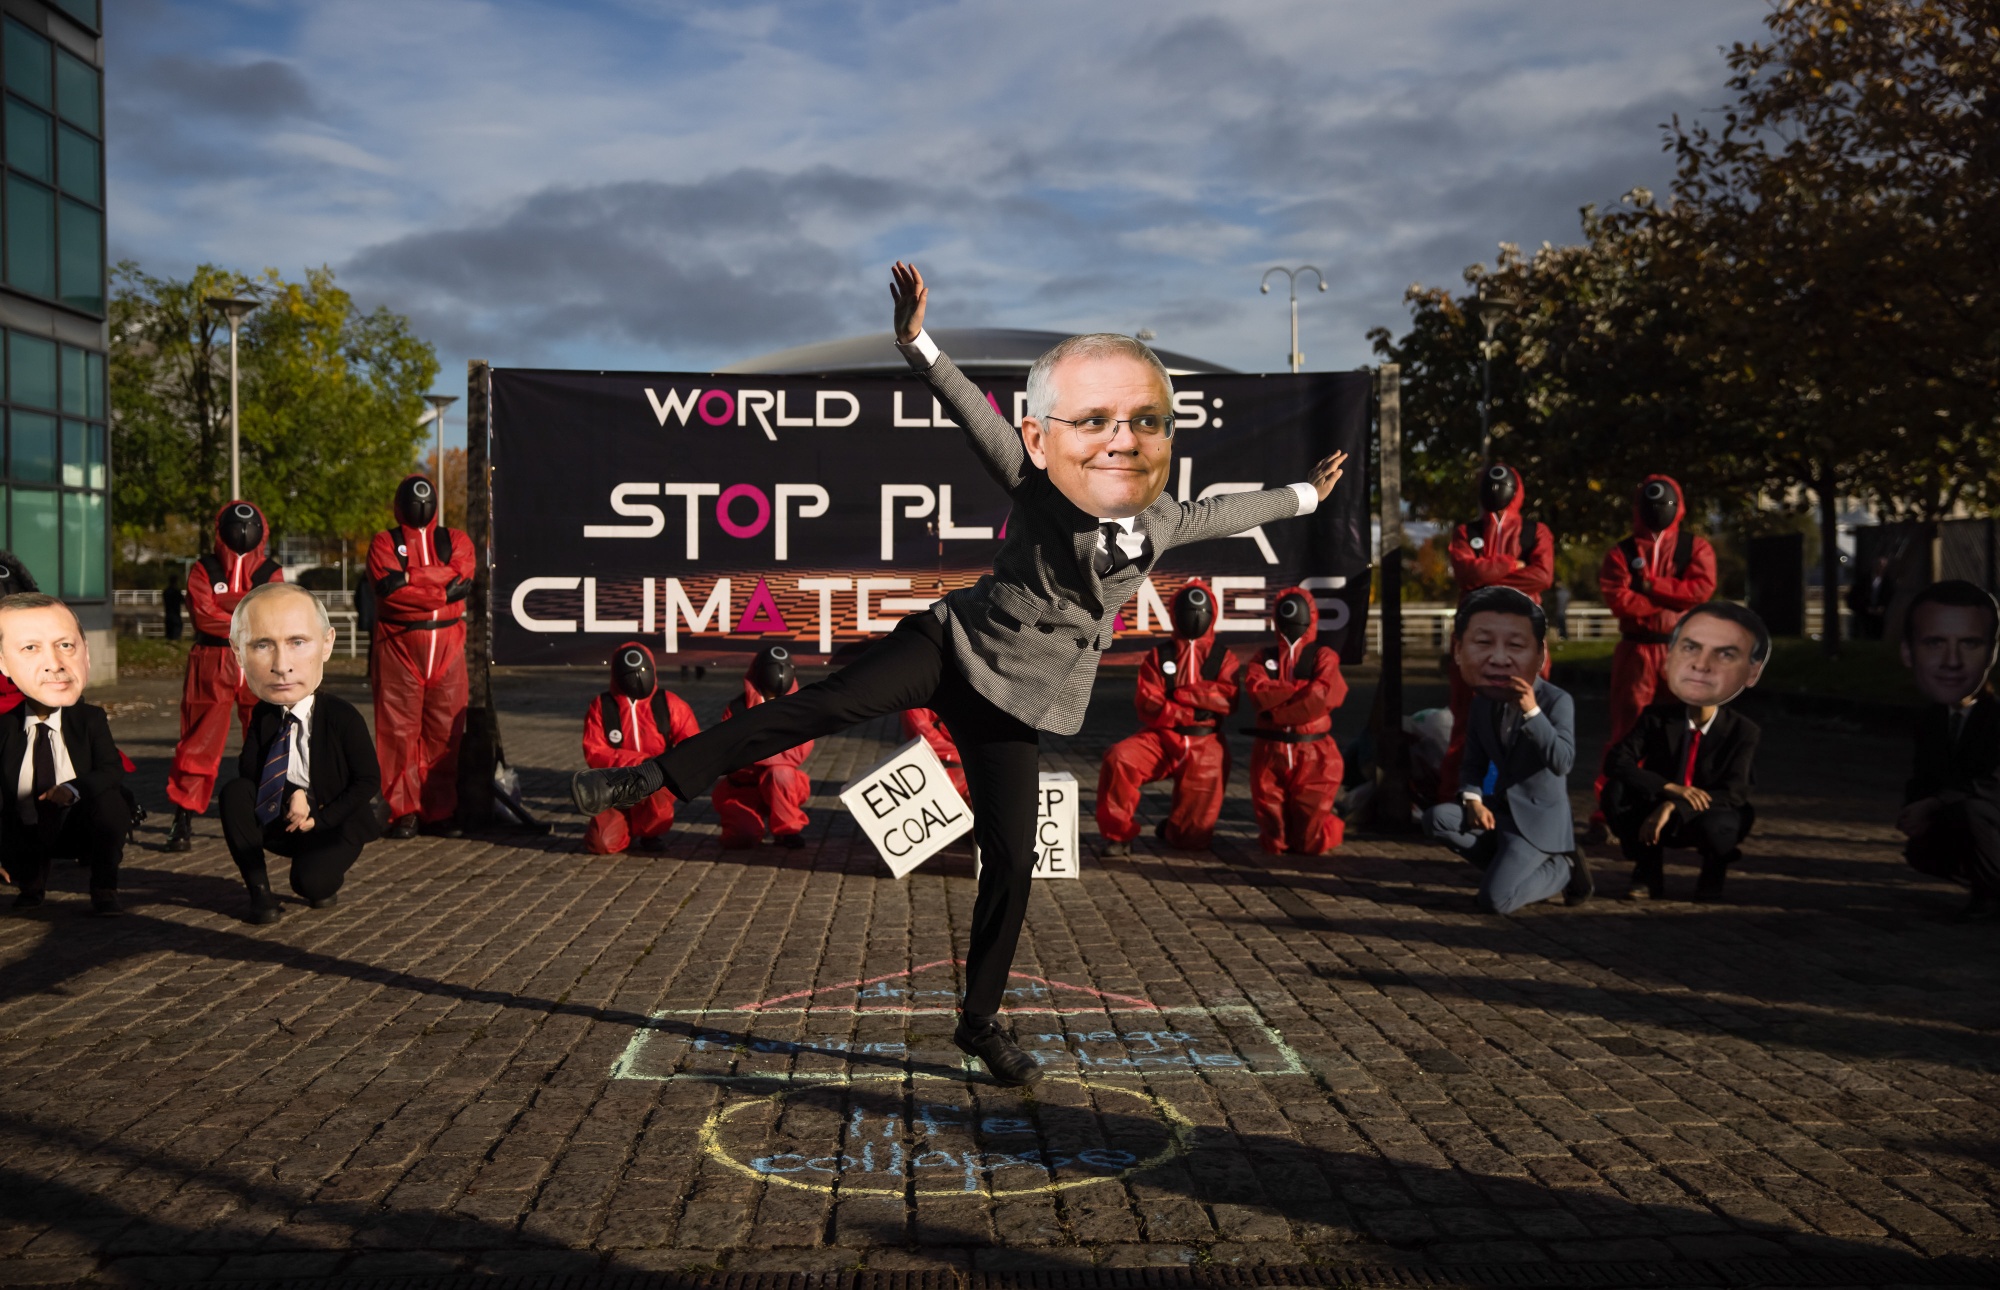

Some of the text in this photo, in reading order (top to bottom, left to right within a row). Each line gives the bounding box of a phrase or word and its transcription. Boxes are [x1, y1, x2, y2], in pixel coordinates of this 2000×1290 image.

[644, 388, 860, 440] WORLD
[584, 482, 830, 560] STOP
[511, 575, 942, 653] CLIMATE
[861, 763, 926, 819] END
[883, 799, 963, 857] COAL
[849, 1104, 1036, 1138] life
[749, 1141, 1136, 1191] collapse
